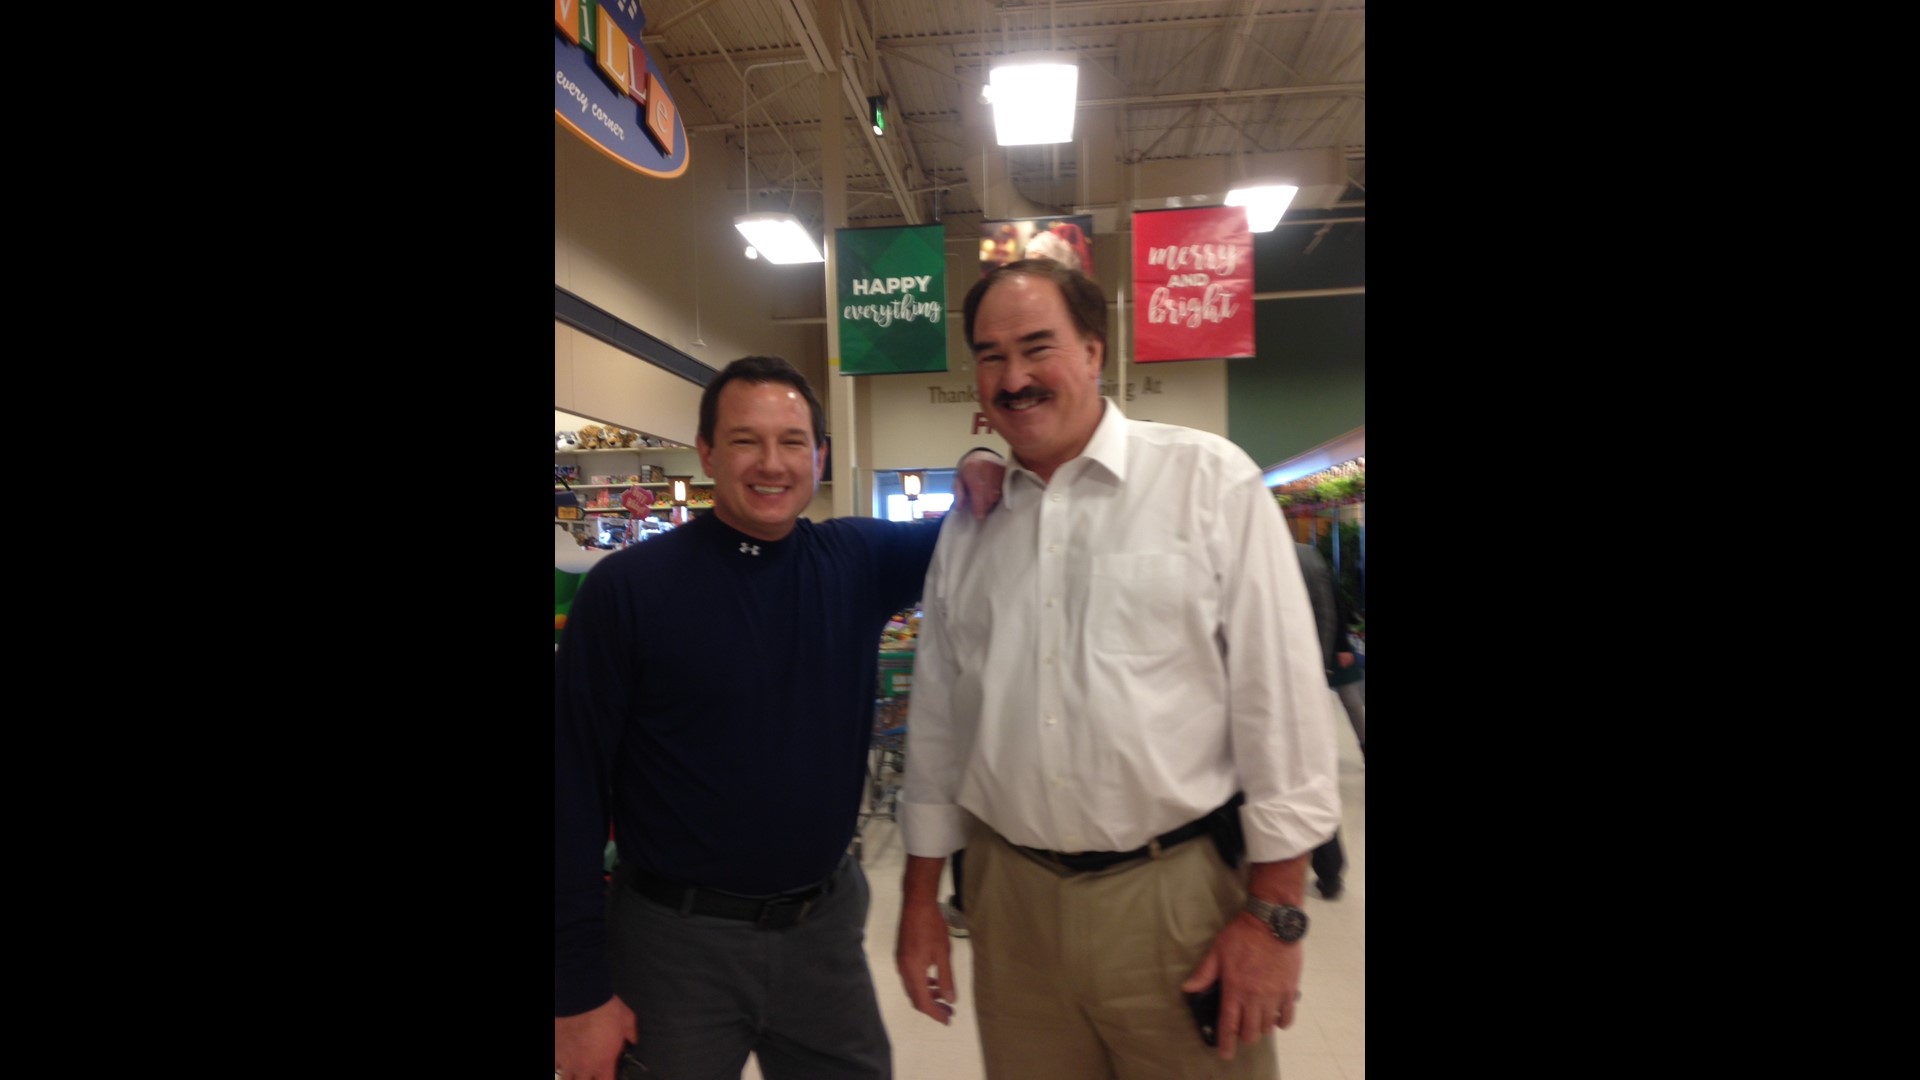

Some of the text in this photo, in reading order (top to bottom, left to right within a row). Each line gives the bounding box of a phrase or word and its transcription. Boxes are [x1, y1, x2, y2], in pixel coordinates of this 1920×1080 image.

[556, 70, 625, 141] every corner
[1148, 244, 1238, 276] merry
[852, 275, 932, 295] HAPPY
[1167, 272, 1210, 289] AND
[843, 293, 942, 328] everything
[1148, 284, 1240, 328] bright
[1141, 375, 1163, 395] At
